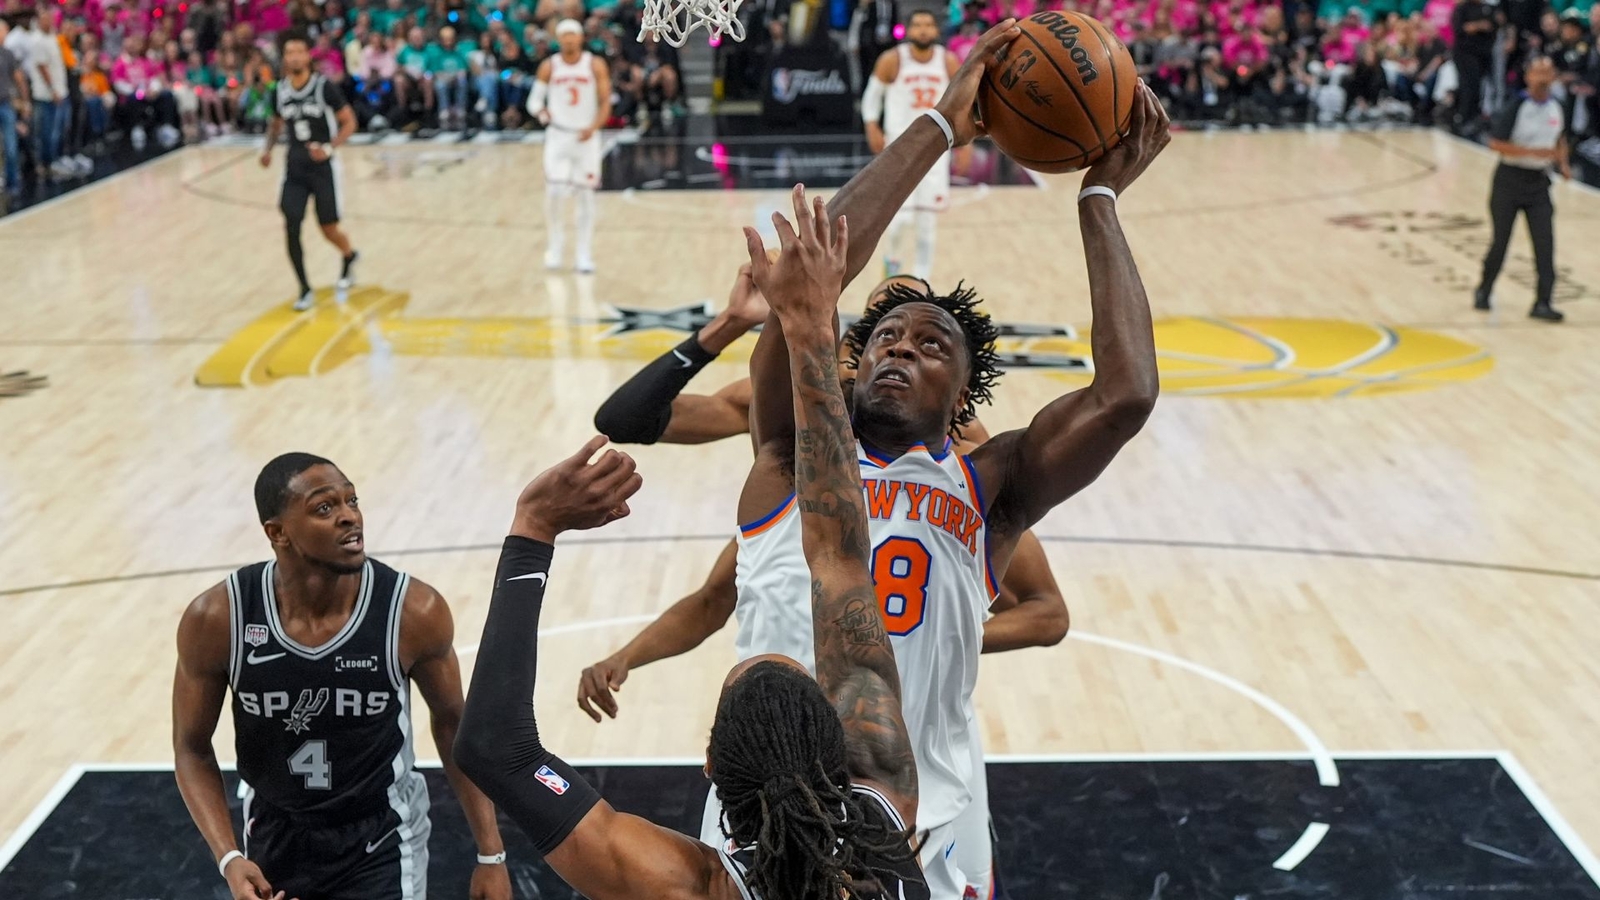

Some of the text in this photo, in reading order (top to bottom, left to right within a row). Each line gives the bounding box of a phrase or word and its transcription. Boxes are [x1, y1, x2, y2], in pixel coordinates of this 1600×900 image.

[1030, 11, 1098, 86] Wilson
[904, 481, 983, 557] YORK
[871, 535, 932, 637] 8
[340, 660, 372, 668] LEDGER
[238, 687, 390, 735] SPURS
[287, 739, 332, 791] 4
